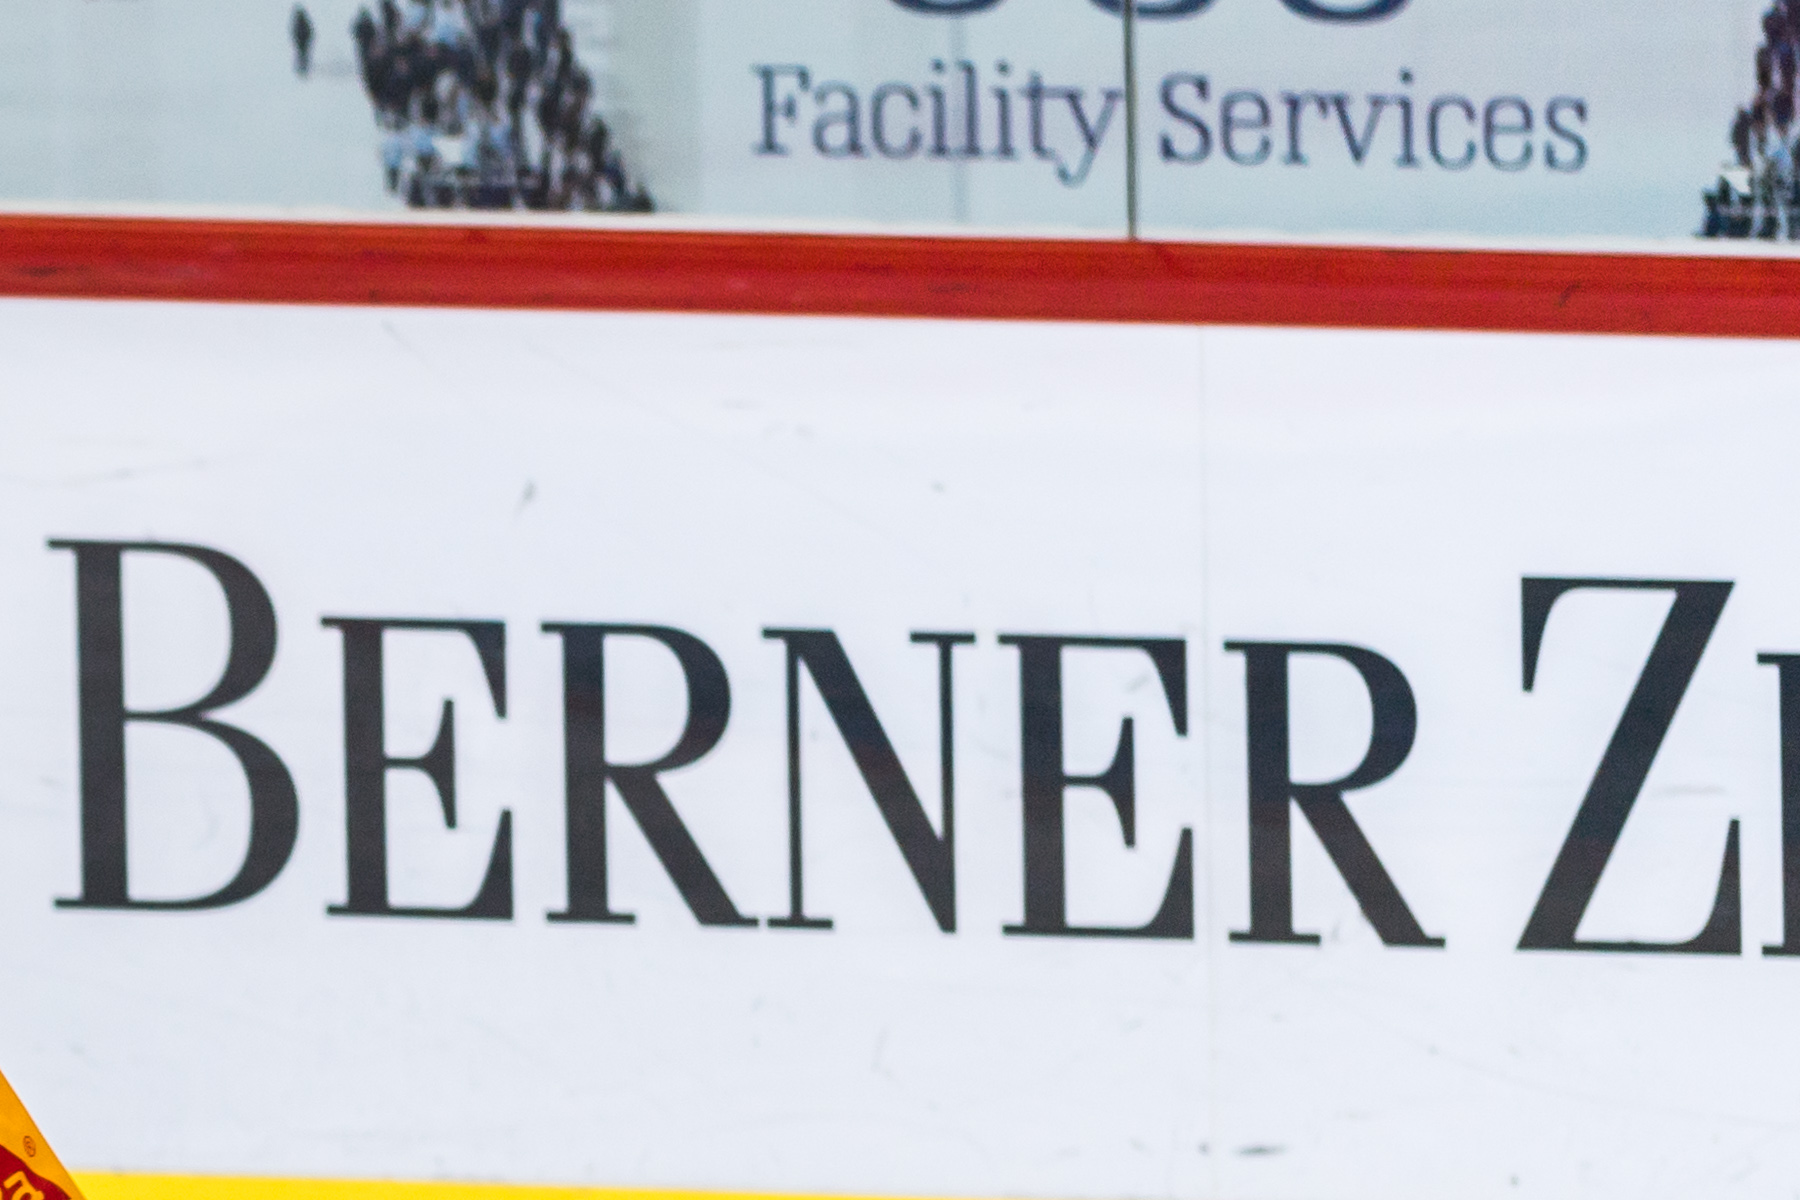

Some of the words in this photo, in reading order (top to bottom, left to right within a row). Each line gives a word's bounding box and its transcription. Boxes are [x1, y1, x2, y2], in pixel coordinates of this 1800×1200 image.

[751, 59, 1125, 187] Facility
[1157, 69, 1590, 172] Services
[46, 537, 1447, 951] BERNER
